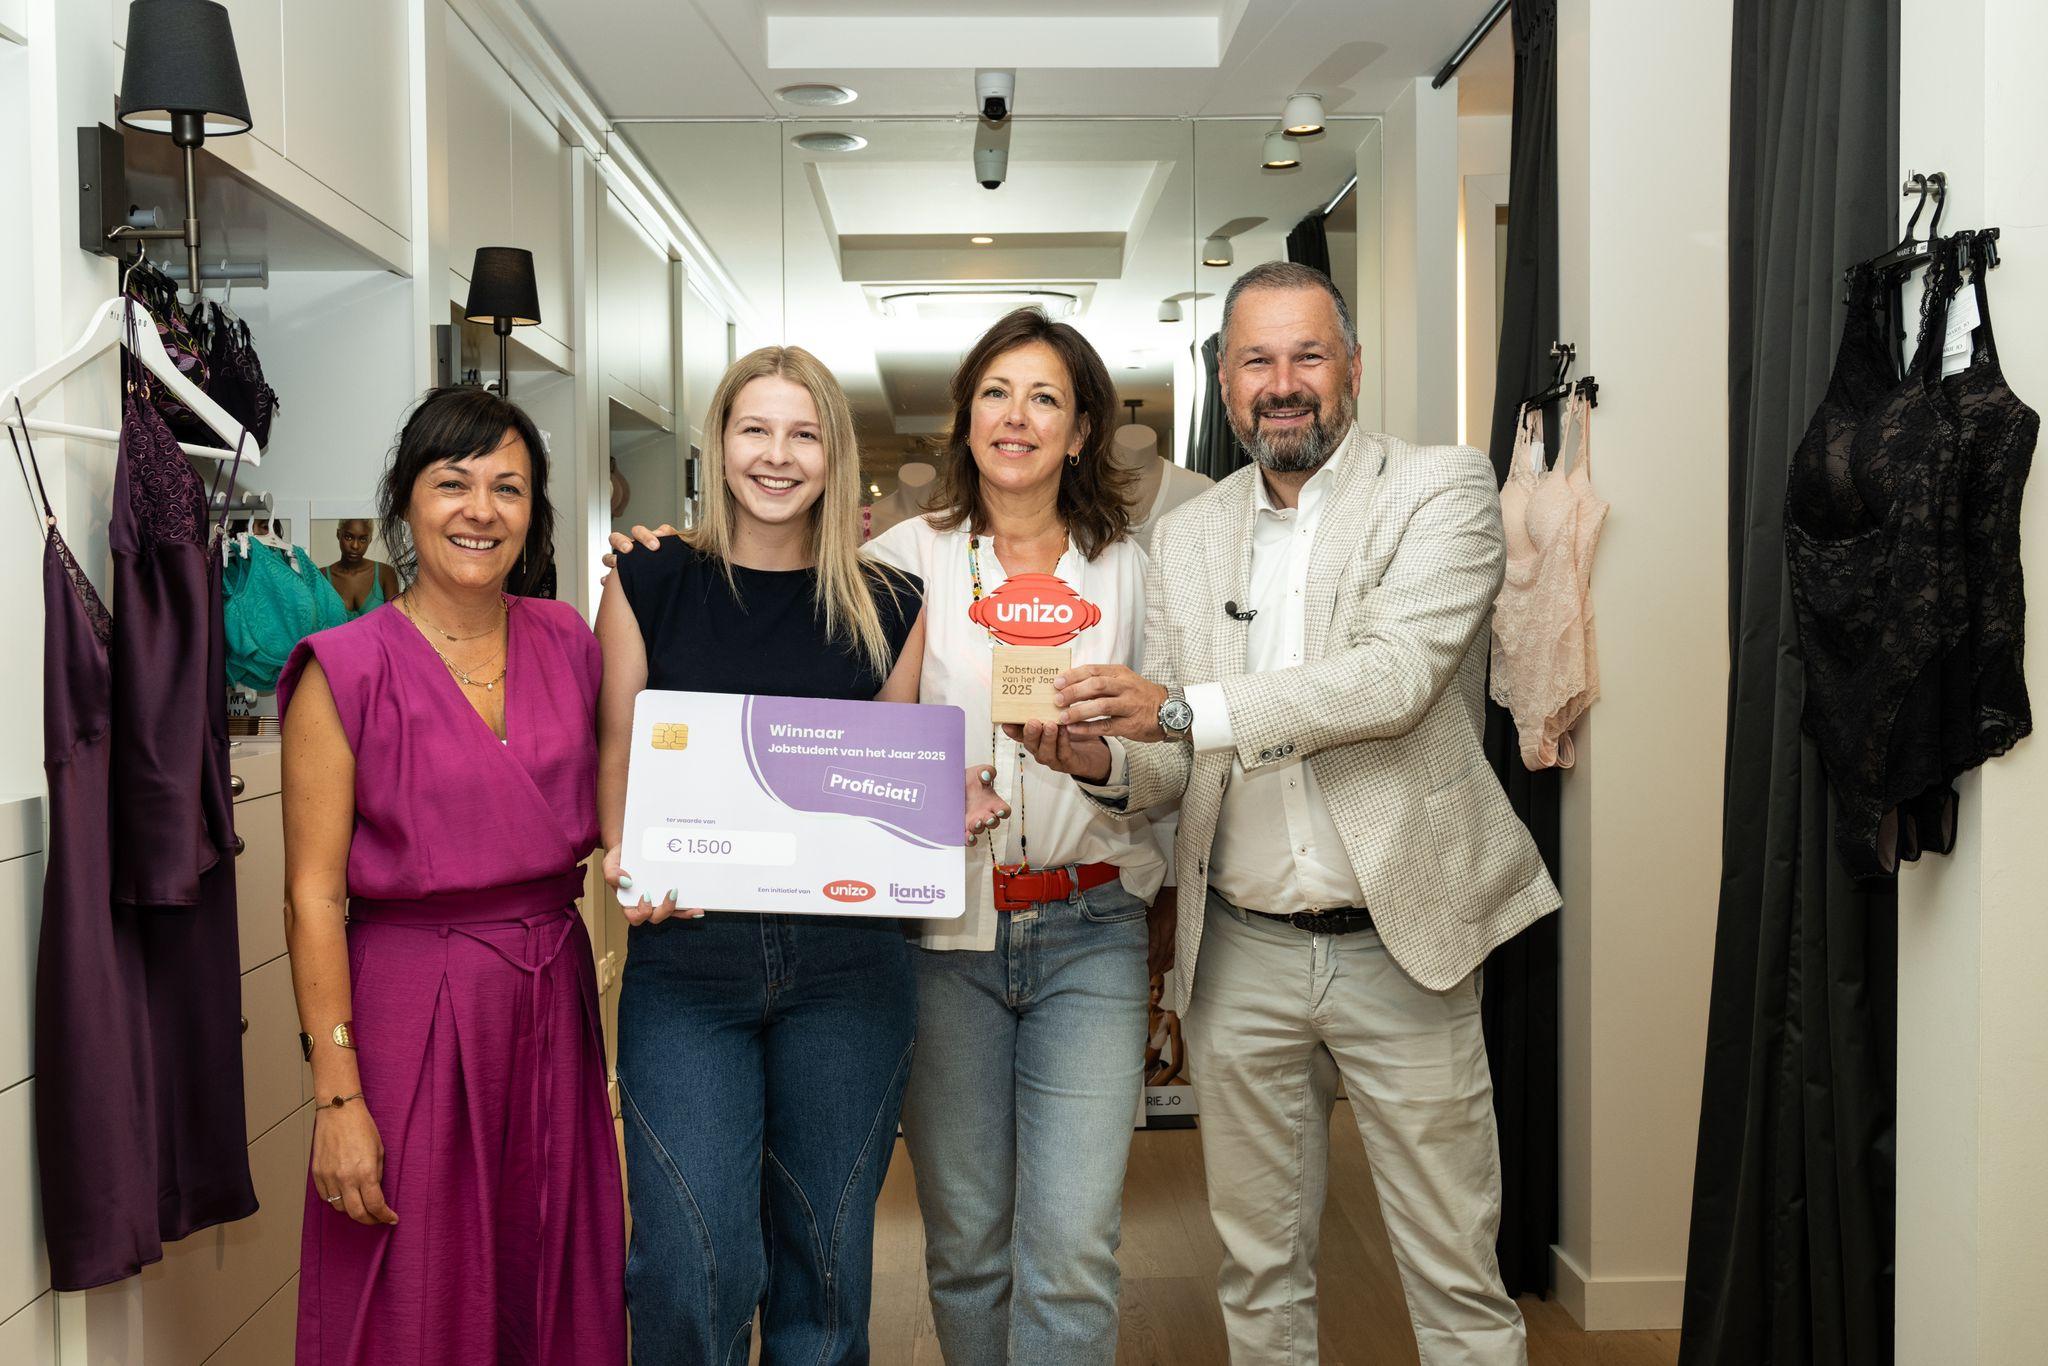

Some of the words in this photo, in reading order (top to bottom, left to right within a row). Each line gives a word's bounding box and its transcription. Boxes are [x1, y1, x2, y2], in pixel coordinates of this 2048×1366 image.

[997, 597, 1073, 623] unizo
[1002, 665, 1059, 675] Jobstudent
[1021, 676, 1035, 684] het
[1038, 676, 1054, 684] Jaa
[1002, 684, 1032, 695] 2025
[225, 695, 249, 704] IMA
[770, 724, 844, 740] Winnaar
[768, 743, 838, 757] Jobstudent
[840, 748, 863, 757] van
[865, 747, 886, 758] het
[888, 749, 916, 760] Jaar
[917, 750, 946, 761] 2025
[830, 773, 918, 803] Proficiat!
[667, 838, 682, 853] €
[688, 839, 732, 855] 1.500
[830, 884, 868, 897] unizo
[890, 883, 946, 899] liantis
[1146, 1096, 1164, 1106] RIE
[1165, 1096, 1181, 1105] JO
